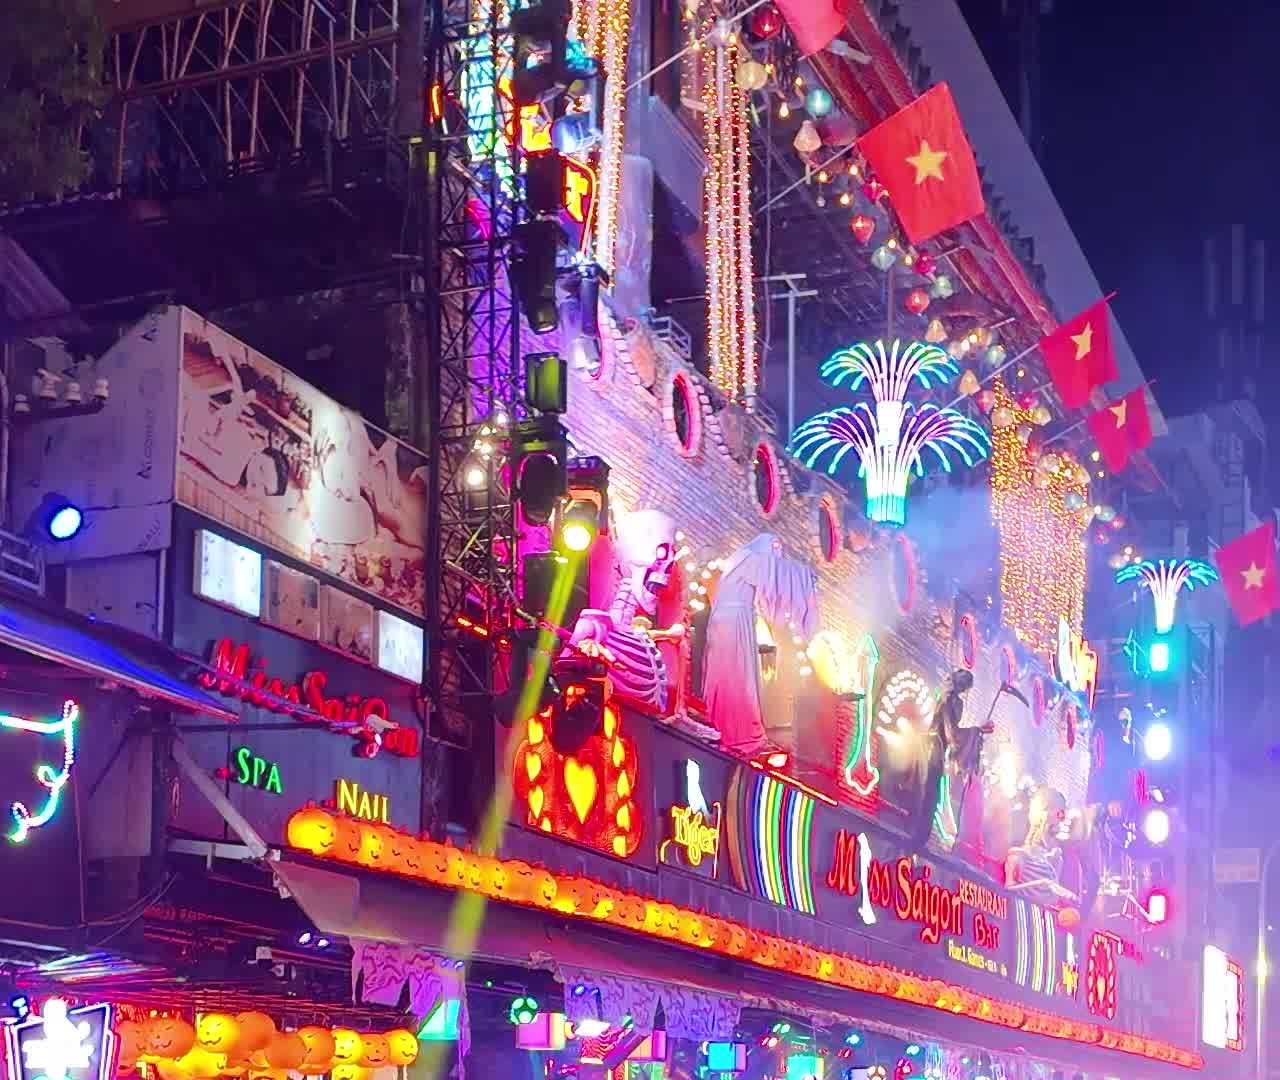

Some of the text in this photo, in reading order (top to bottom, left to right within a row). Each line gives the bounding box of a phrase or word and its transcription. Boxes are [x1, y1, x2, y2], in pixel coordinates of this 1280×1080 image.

[237, 747, 282, 794] SPA
[338, 778, 391, 823] NAIL
[895, 856, 963, 944] Saigon
